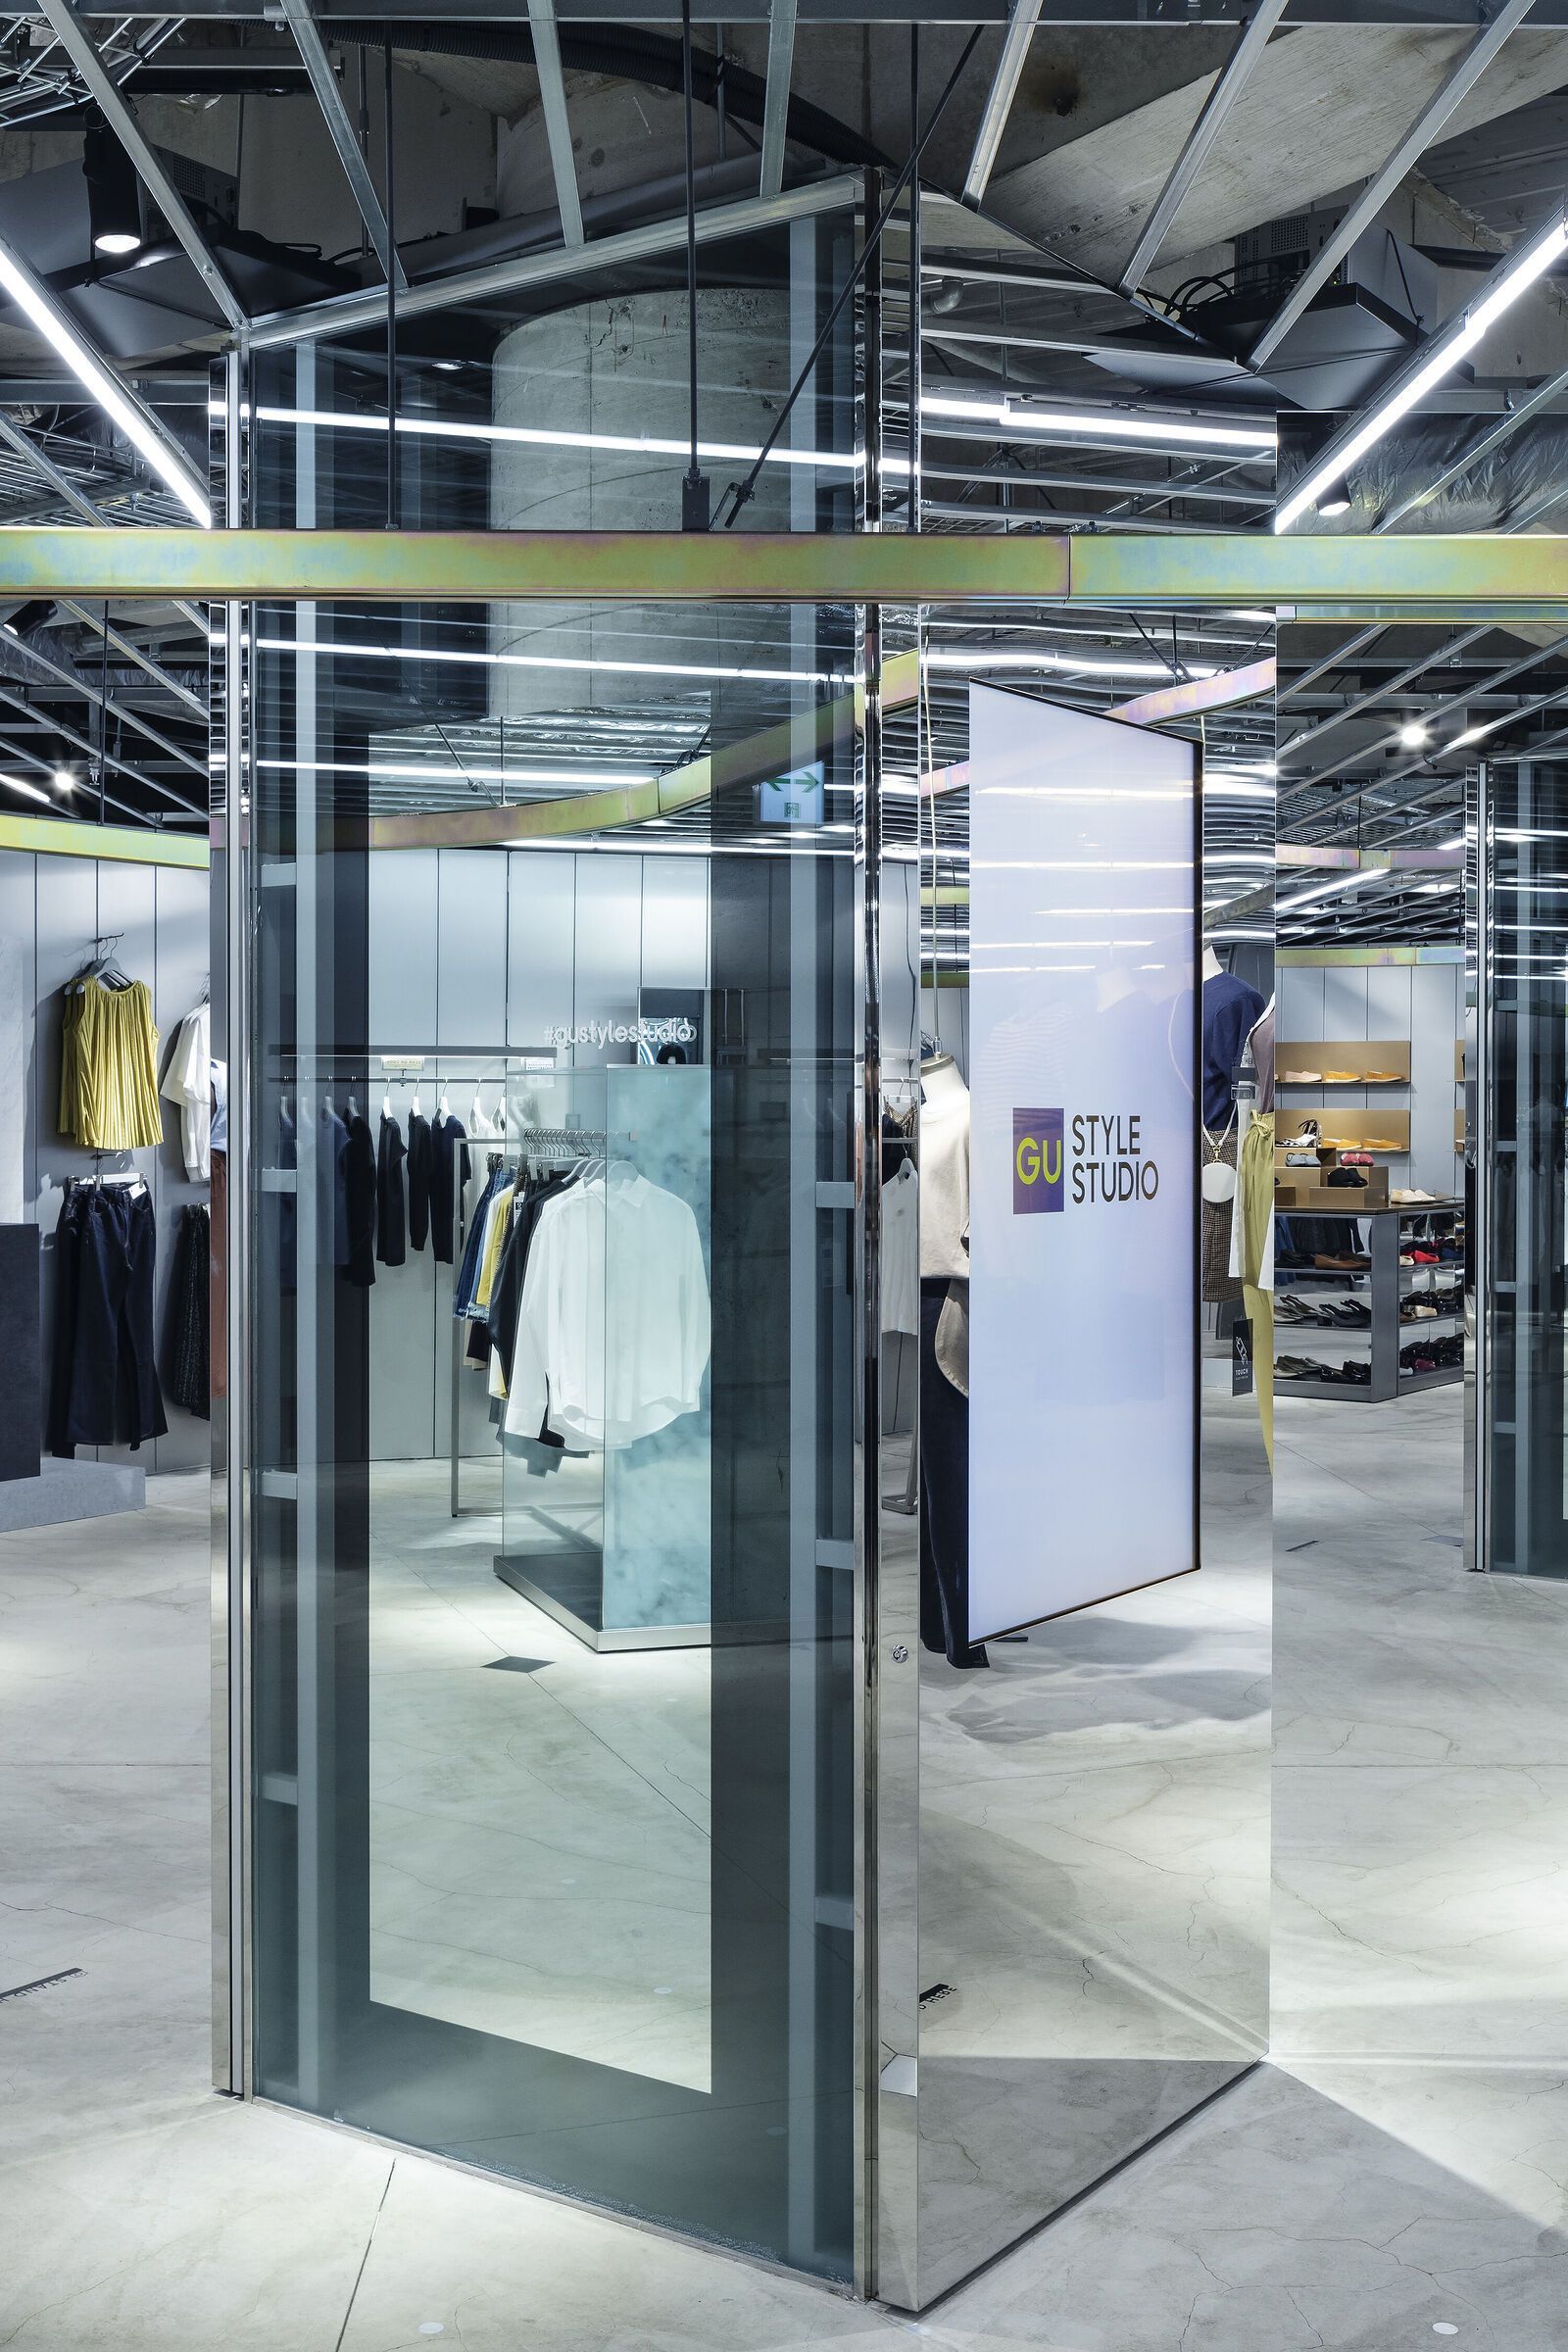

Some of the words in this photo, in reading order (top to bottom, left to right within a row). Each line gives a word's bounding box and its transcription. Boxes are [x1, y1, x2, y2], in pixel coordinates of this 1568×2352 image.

[1071, 1114, 1141, 1156] STYLE
[1016, 1137, 1061, 1185] GU
[1071, 1160, 1159, 1204] STUDIO
